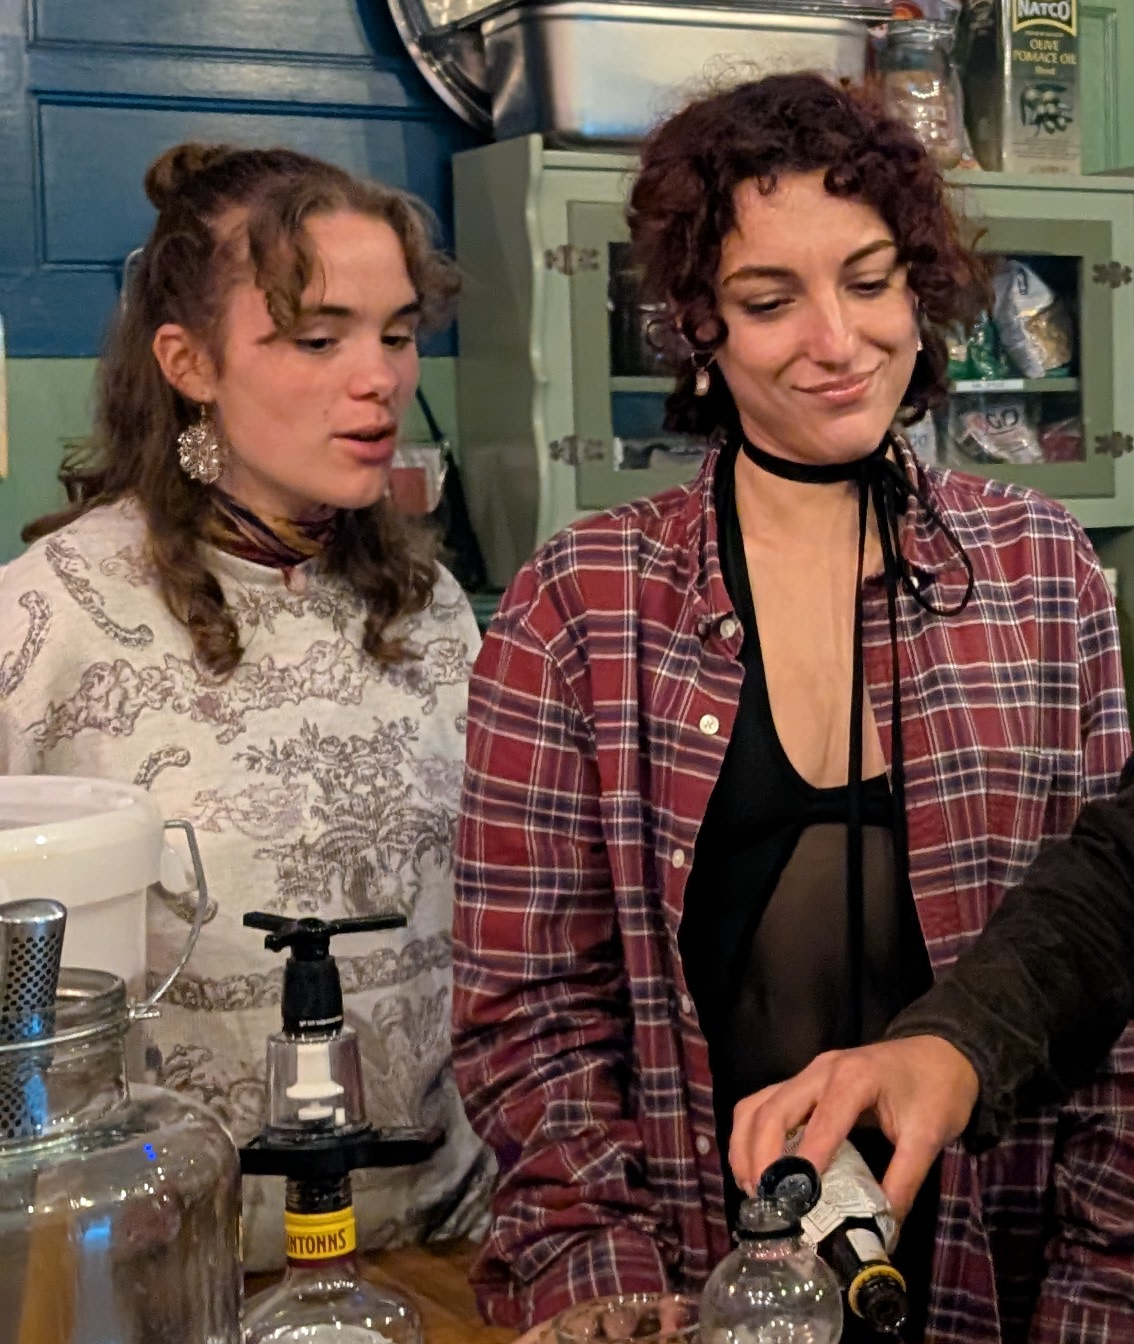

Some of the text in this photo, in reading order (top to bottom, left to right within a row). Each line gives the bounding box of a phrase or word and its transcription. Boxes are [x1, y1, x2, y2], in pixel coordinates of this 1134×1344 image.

[1029, 38, 1059, 51] OLIVE
[1012, 49, 1077, 65] POMACE OIL
